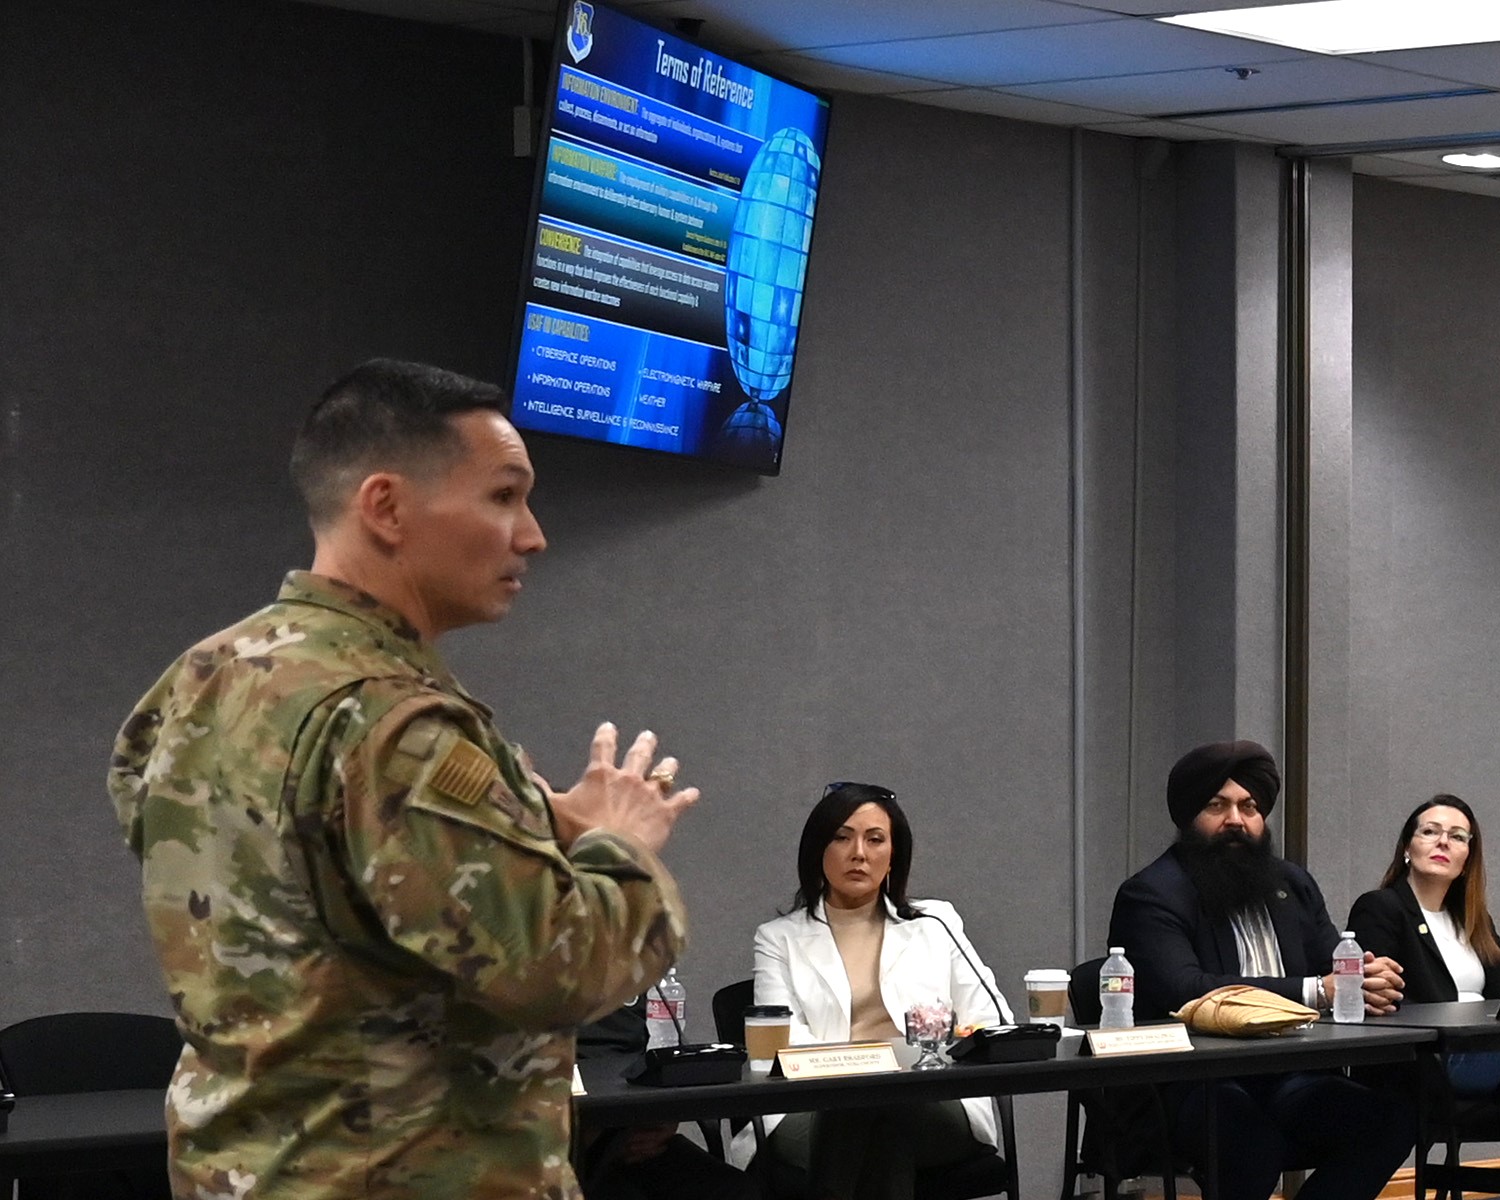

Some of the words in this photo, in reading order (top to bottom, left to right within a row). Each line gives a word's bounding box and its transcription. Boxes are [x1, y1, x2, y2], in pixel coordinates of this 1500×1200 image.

[656, 39, 689, 84] Terms
[690, 57, 704, 89] of
[702, 59, 754, 109] Reference
[536, 345, 579, 364] CYBERSPACE
[579, 354, 616, 371] OPERATIONS
[532, 373, 573, 389] INFORMATION
[573, 381, 611, 397] OPERATIONS
[639, 394, 666, 407] WEATHER
[576, 409, 622, 426] SURVEILLANCE
